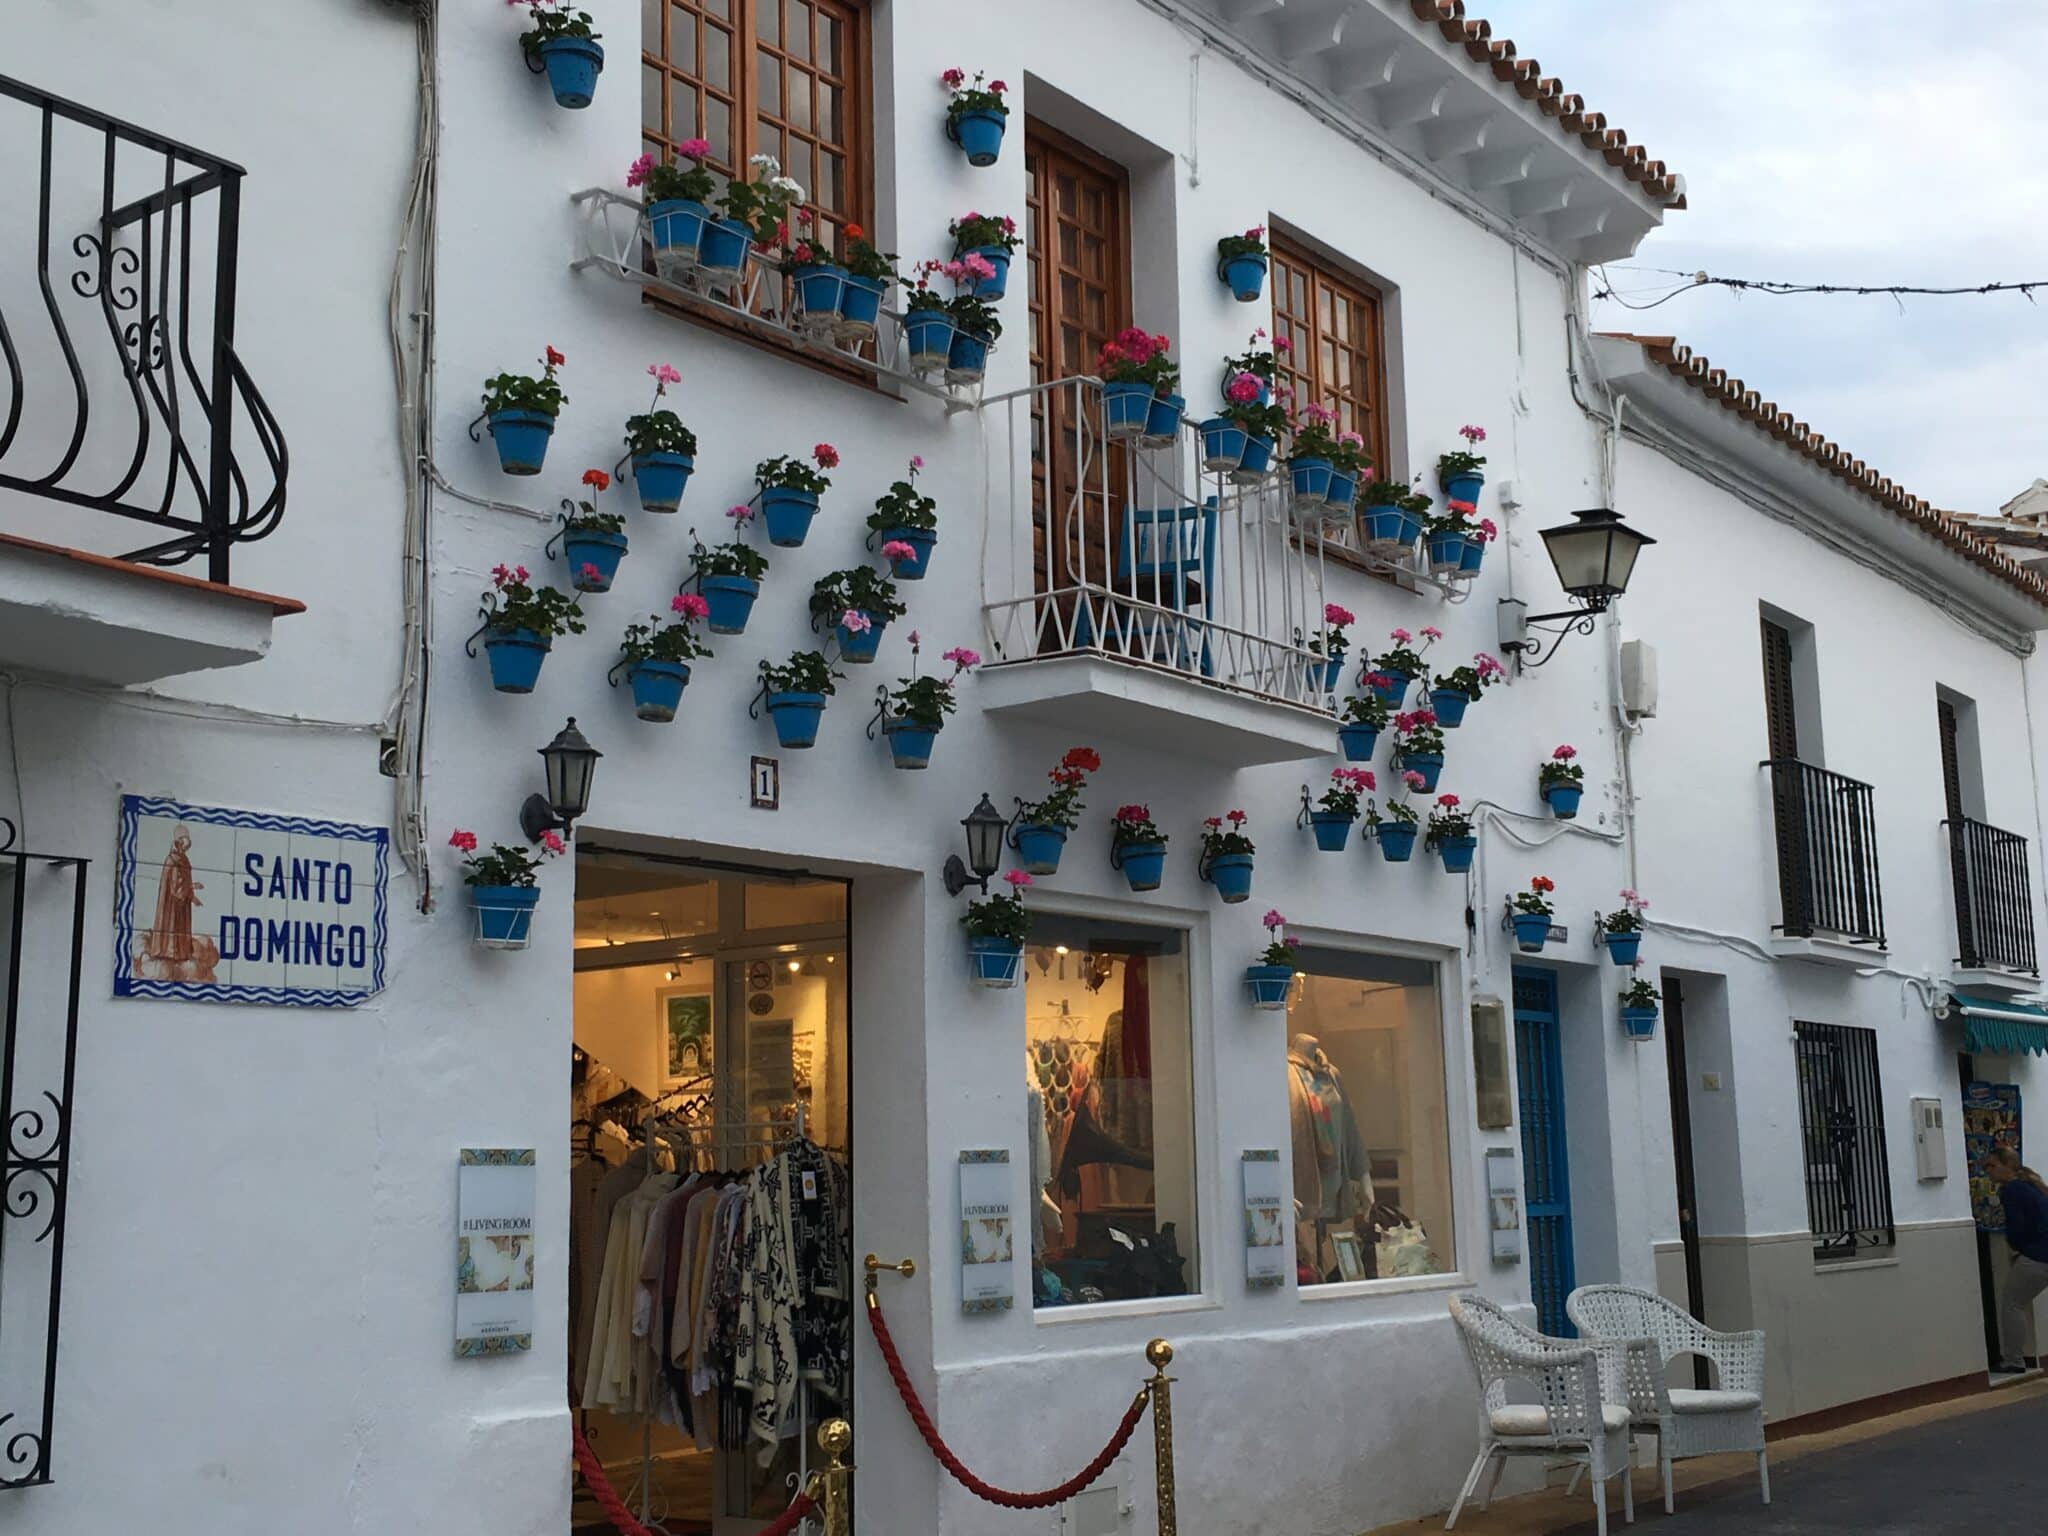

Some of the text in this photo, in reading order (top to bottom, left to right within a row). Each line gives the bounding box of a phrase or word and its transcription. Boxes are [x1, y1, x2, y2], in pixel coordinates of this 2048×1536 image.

[761, 770, 769, 796] 1
[243, 852, 352, 905] SANTO
[219, 915, 366, 969] DOMINGO
[469, 1218, 502, 1231] LIVING
[502, 1217, 531, 1230] ROOM
